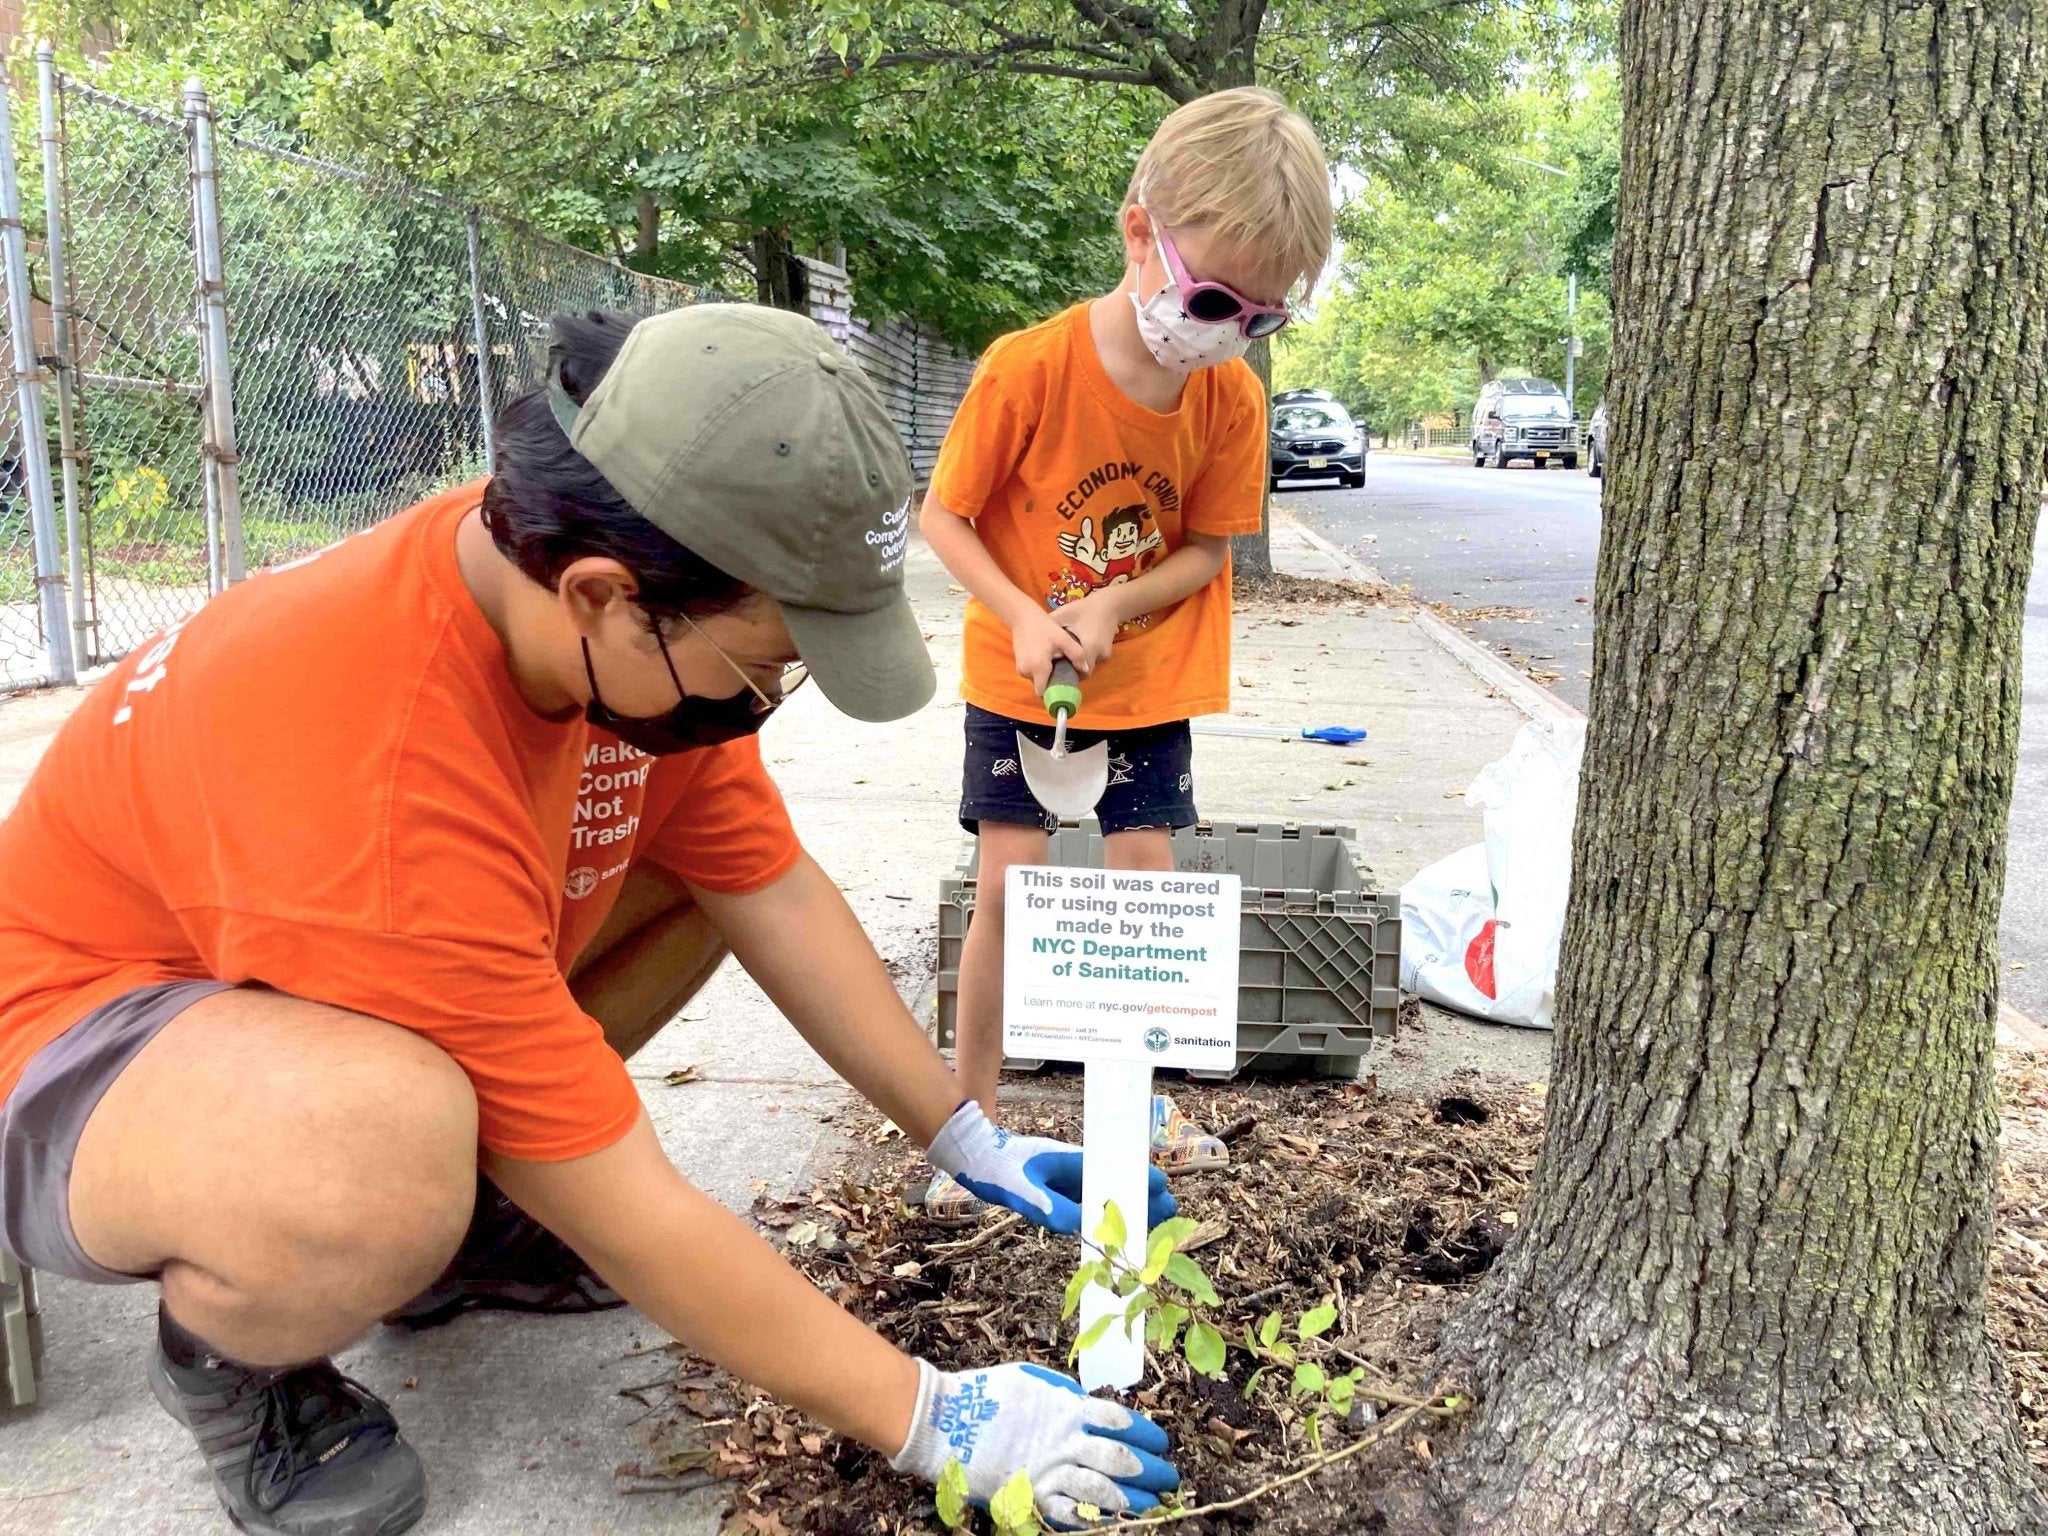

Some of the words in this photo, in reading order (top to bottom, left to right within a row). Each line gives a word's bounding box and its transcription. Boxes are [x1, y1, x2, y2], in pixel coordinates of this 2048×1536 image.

[1144, 471, 1179, 513] CANDY
[573, 796, 623, 822] Not
[571, 815, 640, 849] Trash
[1020, 870, 1063, 888] This
[1070, 874, 1105, 890] soil
[1113, 878, 1154, 892] was
[1161, 880, 1220, 895] cared
[1026, 893, 1055, 909] for
[1062, 897, 1117, 915] using
[1124, 901, 1215, 918] compost
[1056, 919, 1112, 935] made
[1120, 920, 1143, 939] by
[1150, 922, 1184, 938] the
[1032, 937, 1075, 954] NYC
[1083, 940, 1207, 962] Department
[1052, 961, 1073, 977] of
[1079, 962, 1190, 984] Sanitation.
[1024, 996, 1053, 1008] Learn
[1056, 999, 1083, 1009] more
[1086, 1000, 1096, 1010] at
[1099, 1002, 1217, 1017] nyc.gov/getcompost
[1174, 1036, 1231, 1048] sanitation
